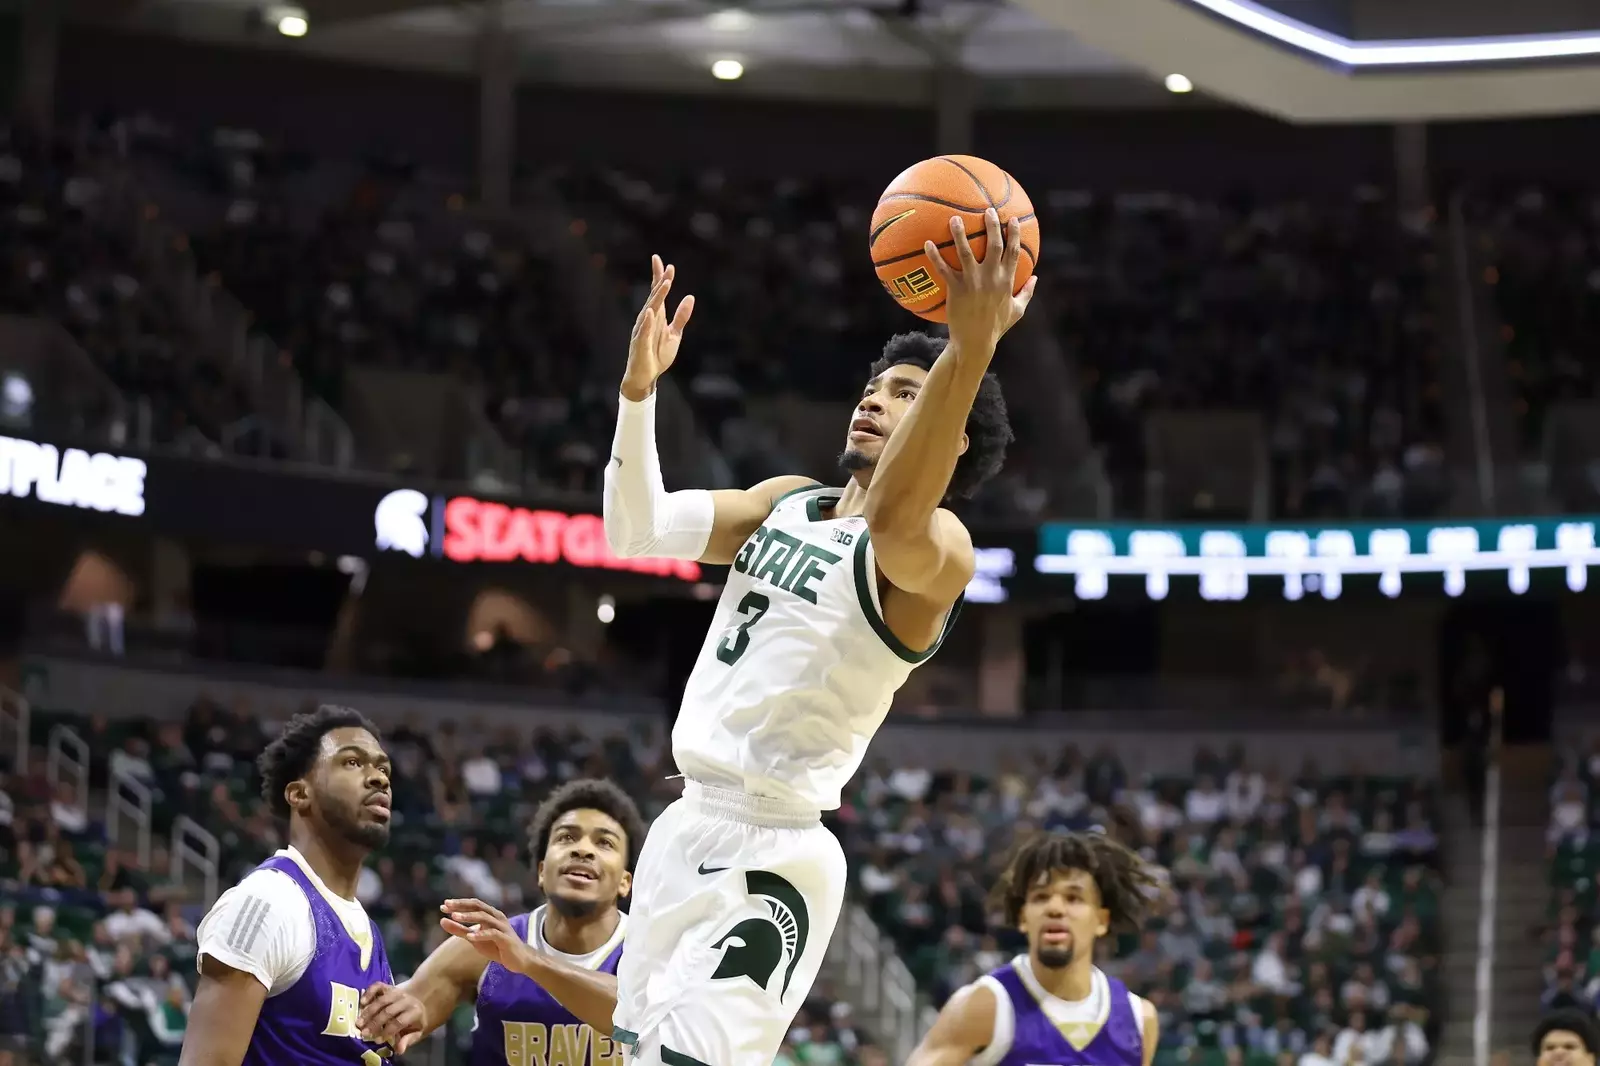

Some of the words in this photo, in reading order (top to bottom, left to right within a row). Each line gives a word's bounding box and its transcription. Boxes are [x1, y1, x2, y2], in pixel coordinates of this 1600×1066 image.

[444, 496, 701, 581] SEATG
[734, 525, 843, 606] STATE
[716, 590, 770, 667] 3
